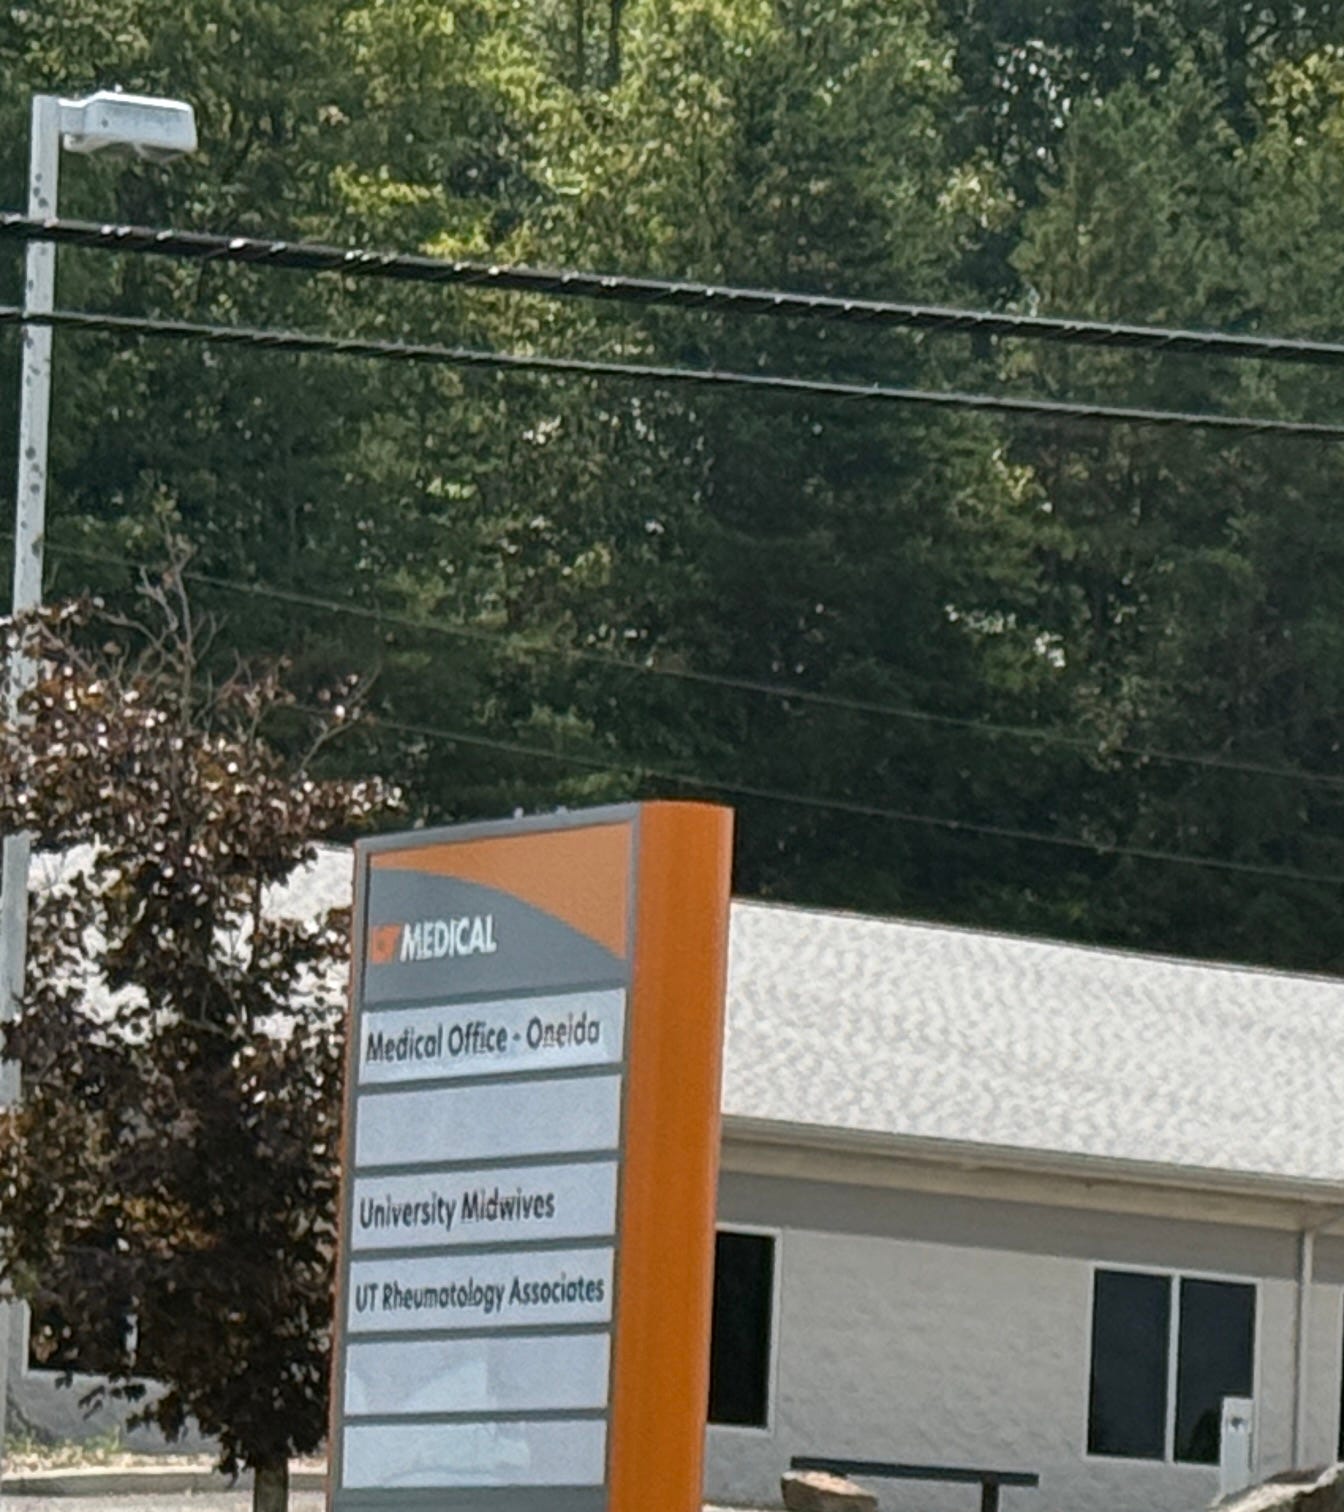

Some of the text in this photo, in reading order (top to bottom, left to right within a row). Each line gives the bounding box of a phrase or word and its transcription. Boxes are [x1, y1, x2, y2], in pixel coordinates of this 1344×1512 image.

[400, 914, 497, 962] MEDICAL
[366, 1022, 442, 1062] Medical
[448, 1020, 507, 1056] Office
[526, 1011, 600, 1051] Oneida
[360, 1187, 555, 1232] University Midwives
[355, 1272, 605, 1314] UT Rheumatology Associates
